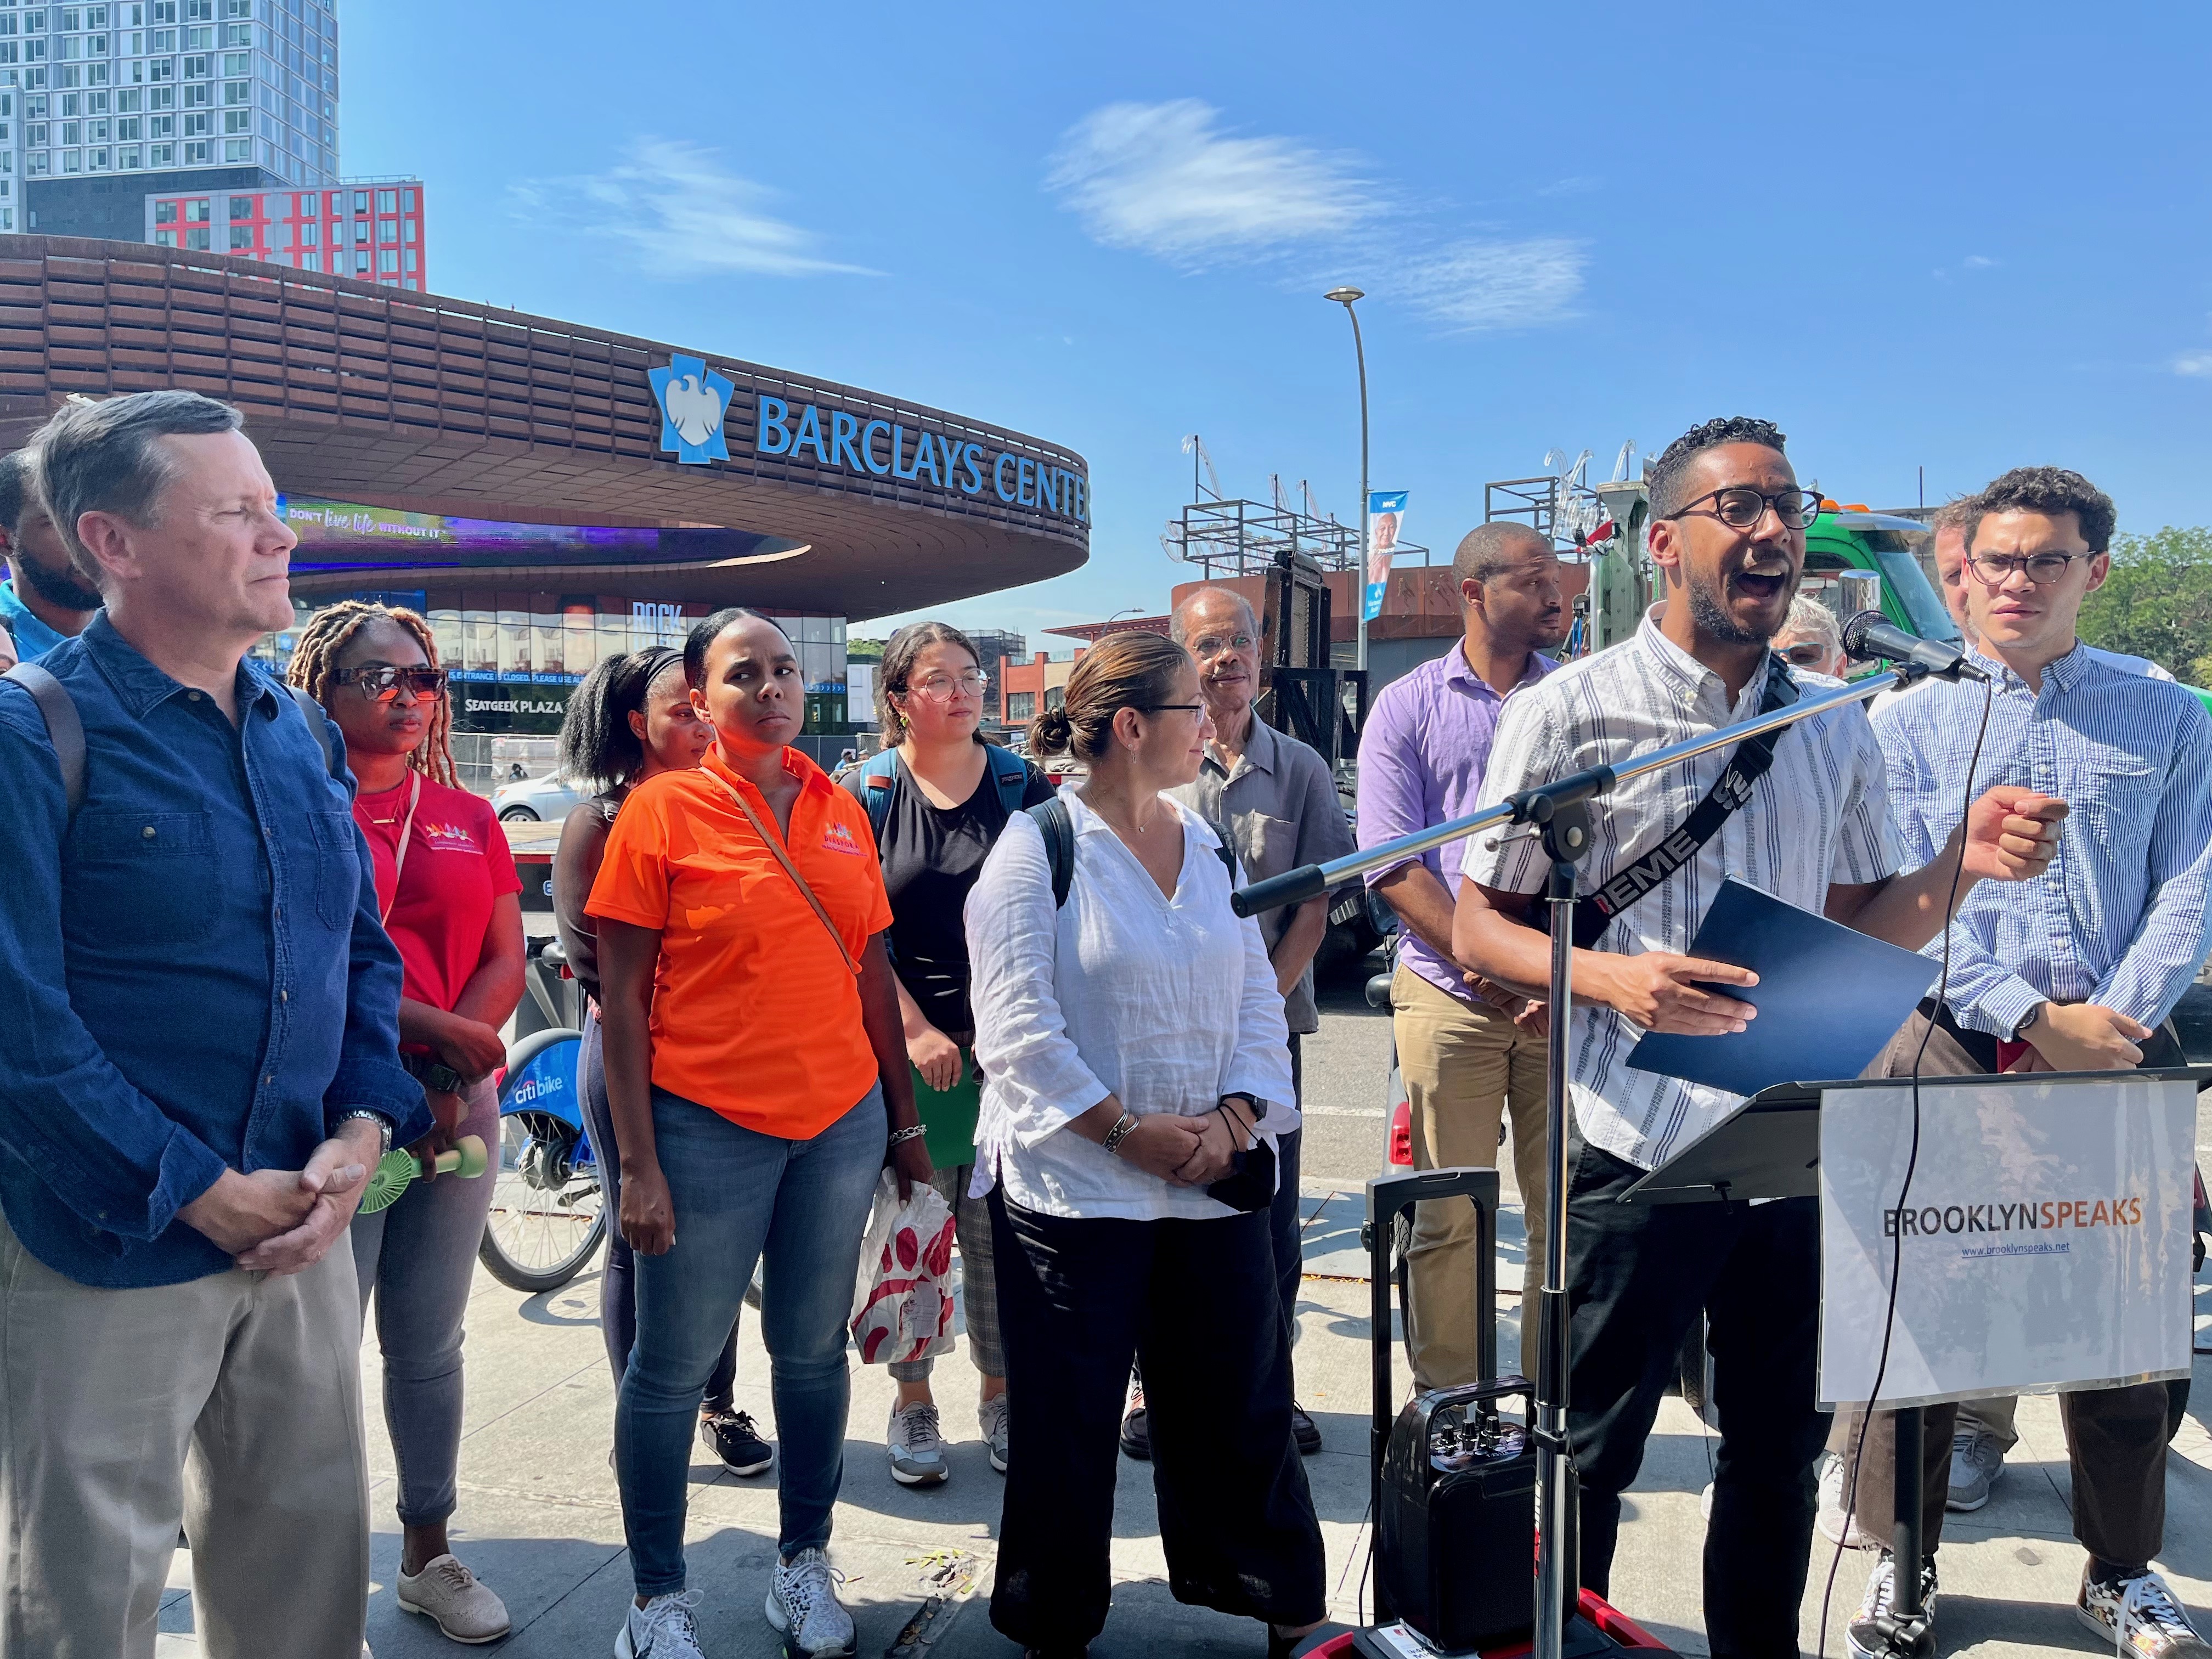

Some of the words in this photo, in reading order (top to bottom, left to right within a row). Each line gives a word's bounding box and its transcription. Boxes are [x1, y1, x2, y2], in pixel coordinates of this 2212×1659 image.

[757, 394, 984, 494] BARCLAYS
[290, 508, 323, 522] DON'T
[325, 509, 350, 529] live
[353, 512, 376, 535] life
[379, 522, 427, 537] WITHOUT
[633, 601, 682, 635] ROCK
[456, 672, 495, 681] ENTRANCE
[531, 674, 557, 683] PLEASE
[558, 675, 572, 684] USE
[465, 698, 519, 713] SEATGEEK
[520, 700, 564, 714] PLAZA
[536, 1075, 563, 1097] bike
[1884, 1198, 2141, 1237] BROOKLYNSPEAKS
[1962, 1242, 2070, 1257] www.brooklynspeaks.net
